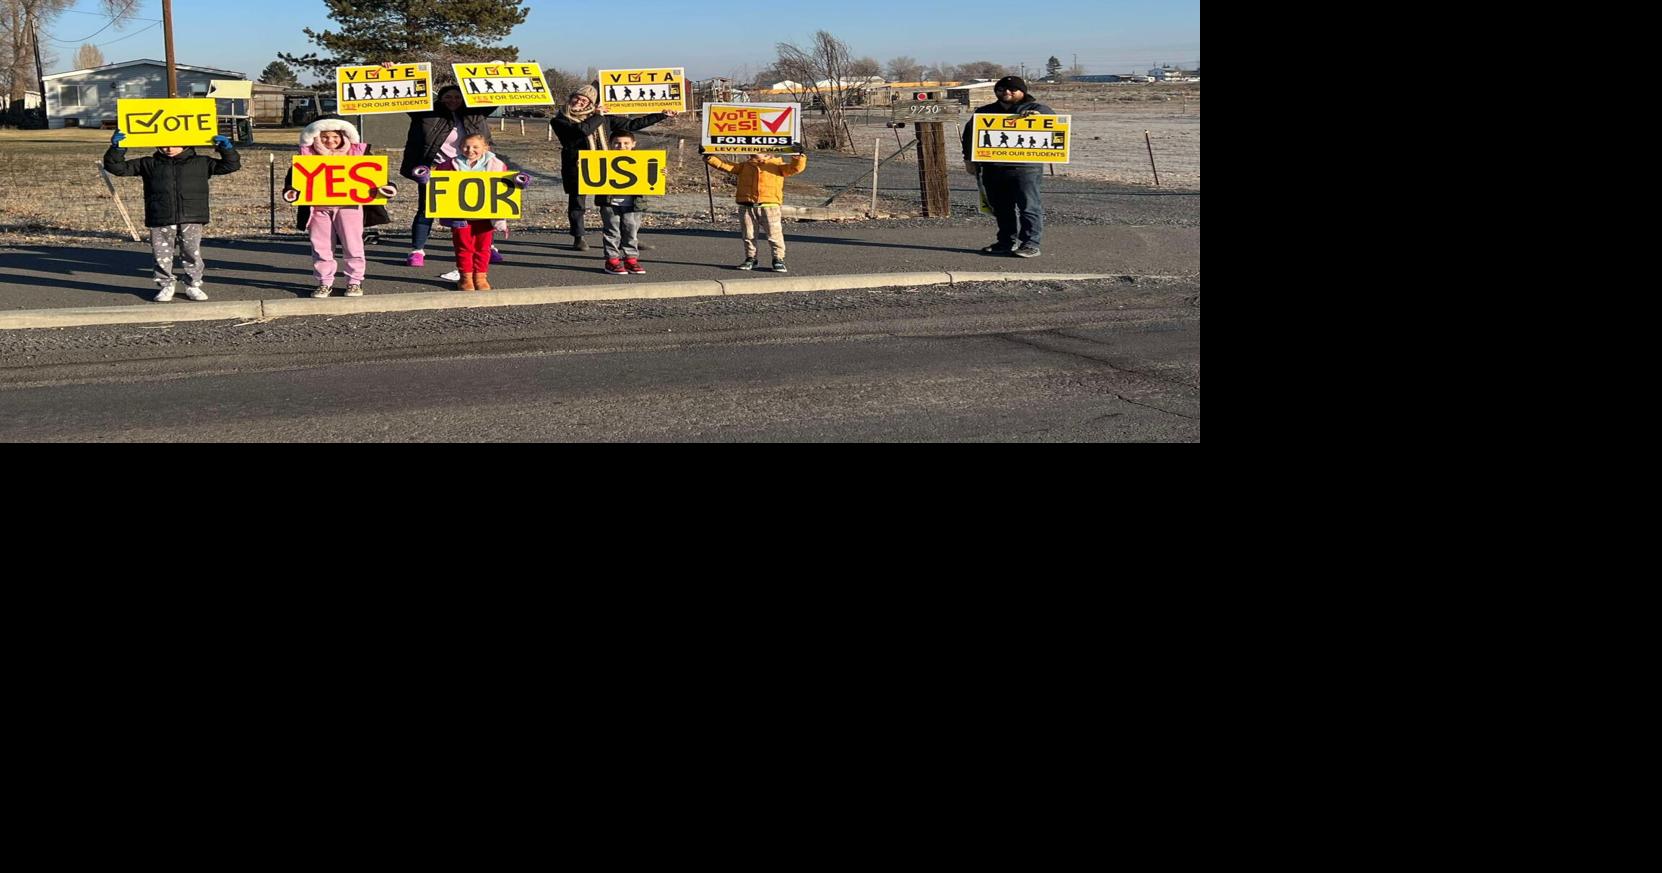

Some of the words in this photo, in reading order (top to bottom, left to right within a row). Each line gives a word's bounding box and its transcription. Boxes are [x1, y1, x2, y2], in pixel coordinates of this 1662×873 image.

[712, 109, 757, 120] VOTE
[910, 104, 940, 114] 9750
[714, 120, 757, 132] YES!
[751, 137, 788, 145] KIDS
[293, 162, 383, 204] YES
[429, 176, 520, 215] FOR
